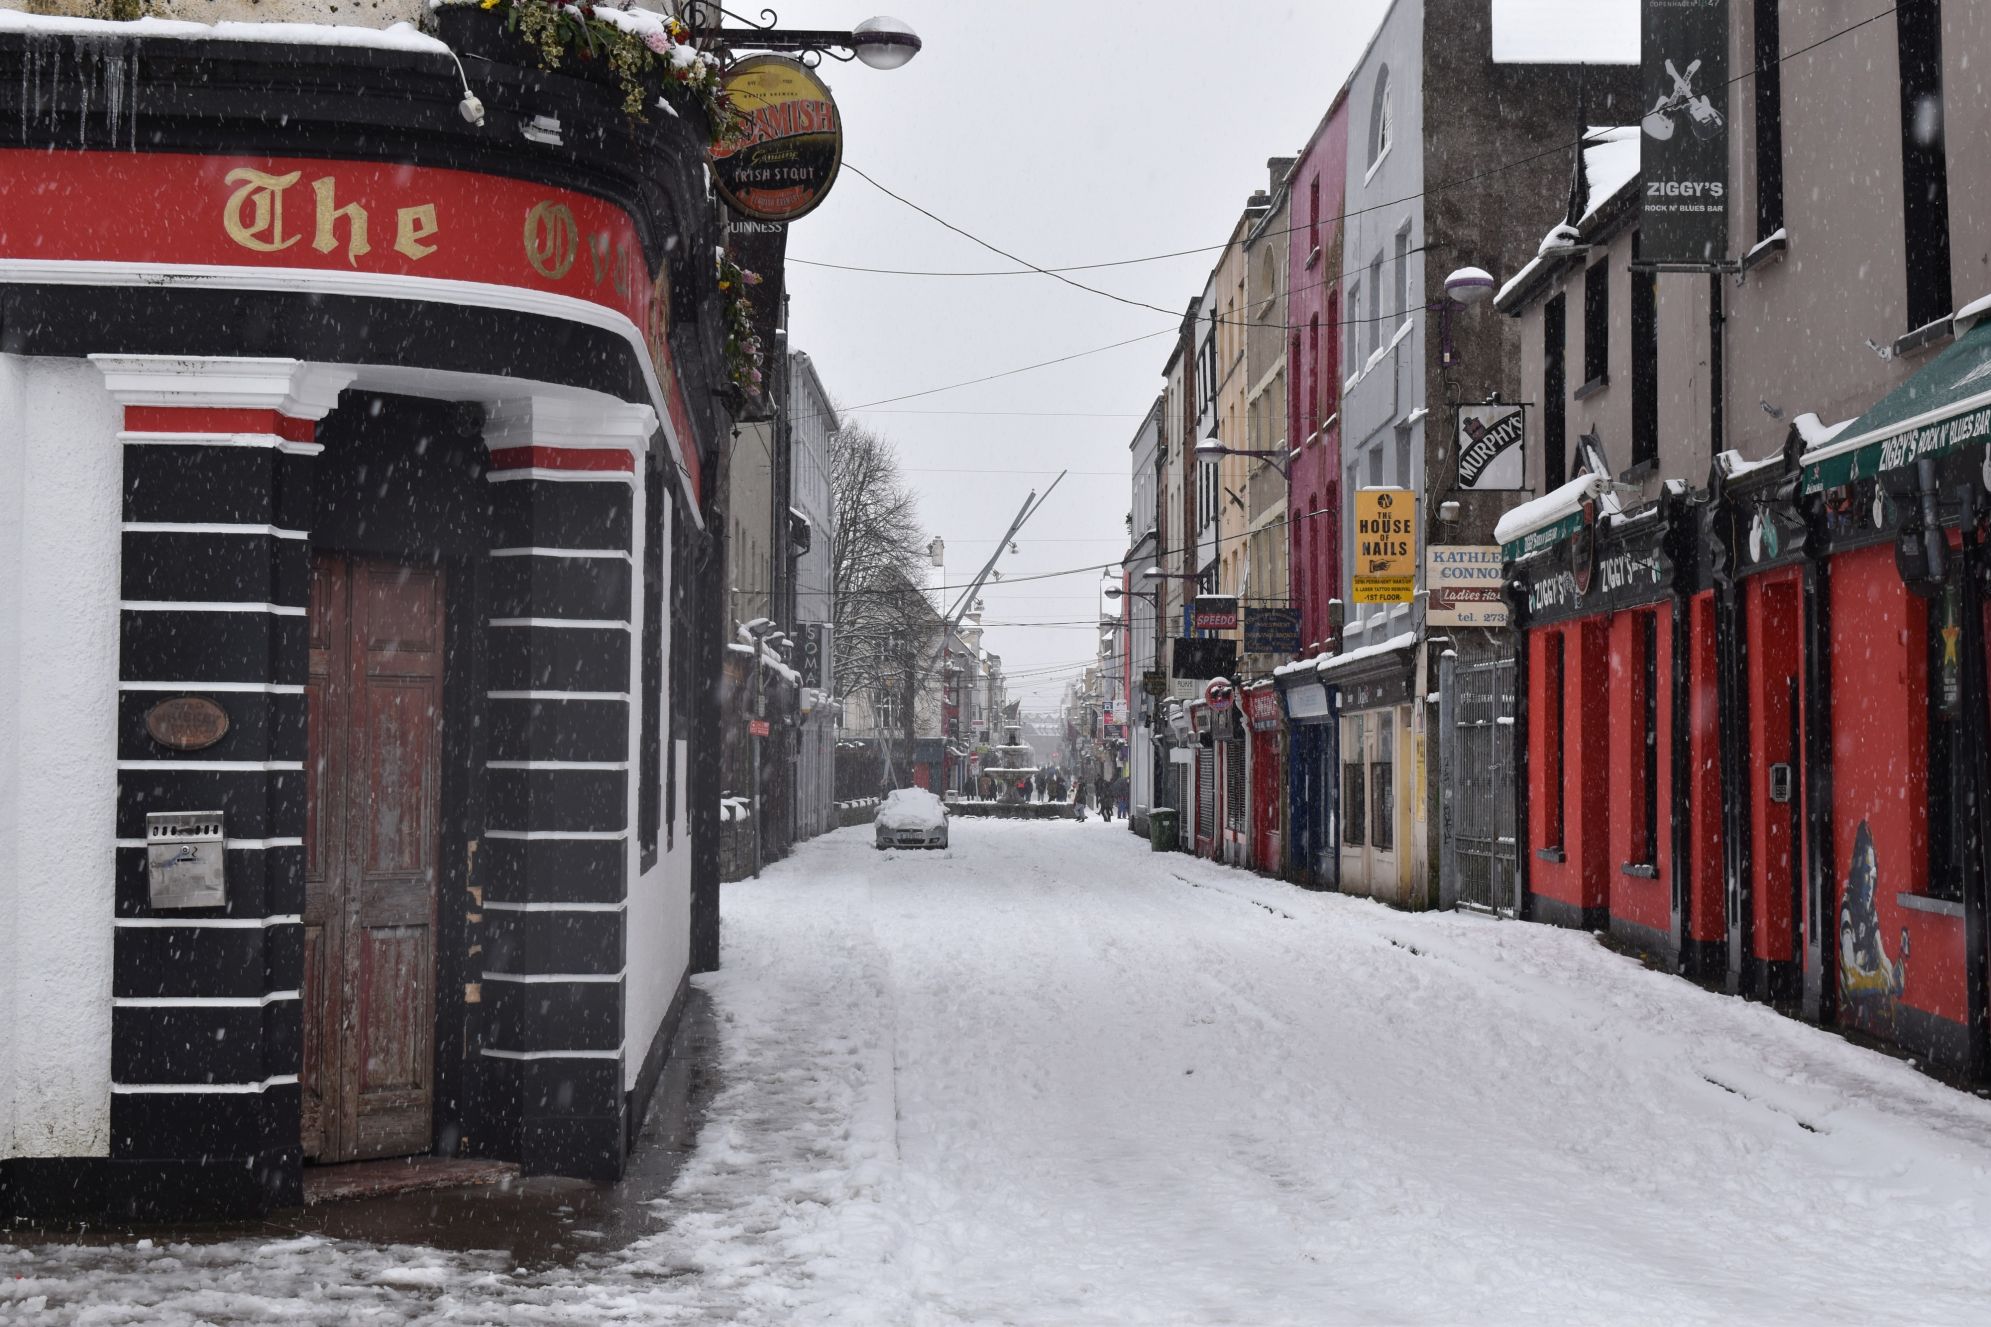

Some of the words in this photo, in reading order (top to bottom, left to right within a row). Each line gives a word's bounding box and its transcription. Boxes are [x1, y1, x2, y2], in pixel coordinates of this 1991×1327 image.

[708, 98, 836, 158] AMISH
[735, 168, 770, 182] IRISH
[774, 167, 814, 181] STOUT
[1646, 182, 1724, 197] ZIGGY'S
[1644, 204, 1668, 212] ROCK
[1679, 204, 1706, 212] BLUES
[1707, 204, 1723, 212] BAR
[223, 167, 439, 268] The
[1878, 429, 1919, 472] ZIGGY'S
[1917, 426, 1939, 454] ROCK
[1950, 413, 1973, 444] BLUES
[1972, 409, 1991, 436] BAR
[1459, 415, 1522, 483] MURPHY'S
[1377, 511, 1392, 520] THE
[1359, 519, 1411, 534] HOUSE
[1379, 534, 1390, 542] OF
[1362, 541, 1407, 556] NAILS
[1600, 553, 1633, 592] ZIGGY'S
[1443, 589, 1480, 600] Ladies
[1534, 573, 1565, 610] ZIGGY'S
[1196, 613, 1236, 626] SPEEDO
[804, 627, 818, 684] SOMA
